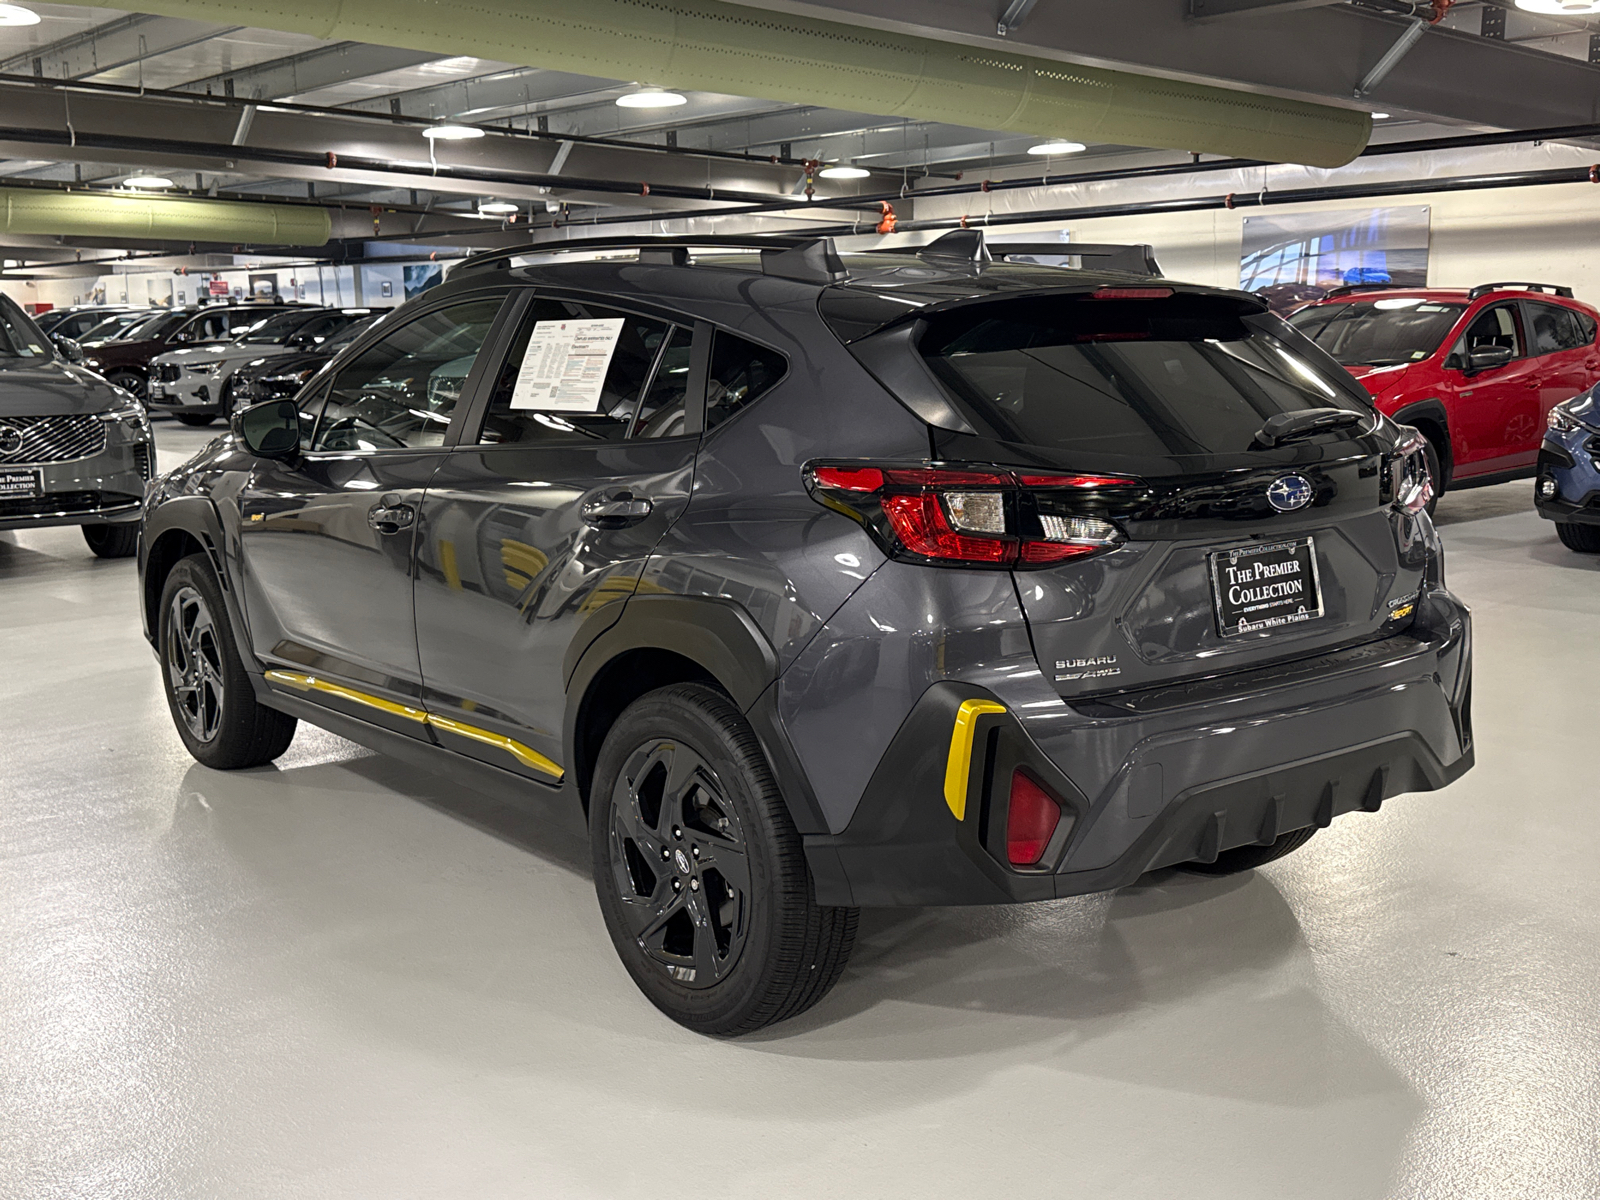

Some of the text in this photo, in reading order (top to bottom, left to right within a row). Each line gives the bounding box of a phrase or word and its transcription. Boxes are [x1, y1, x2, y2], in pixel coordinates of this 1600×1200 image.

[6, 474, 35, 483] PREMIER
[1225, 560, 1301, 585] THE PREMIER
[1228, 579, 1303, 605] COLLECTION
[1238, 613, 1309, 633] Subaru White Plains
[1055, 655, 1117, 669] SUBARU
